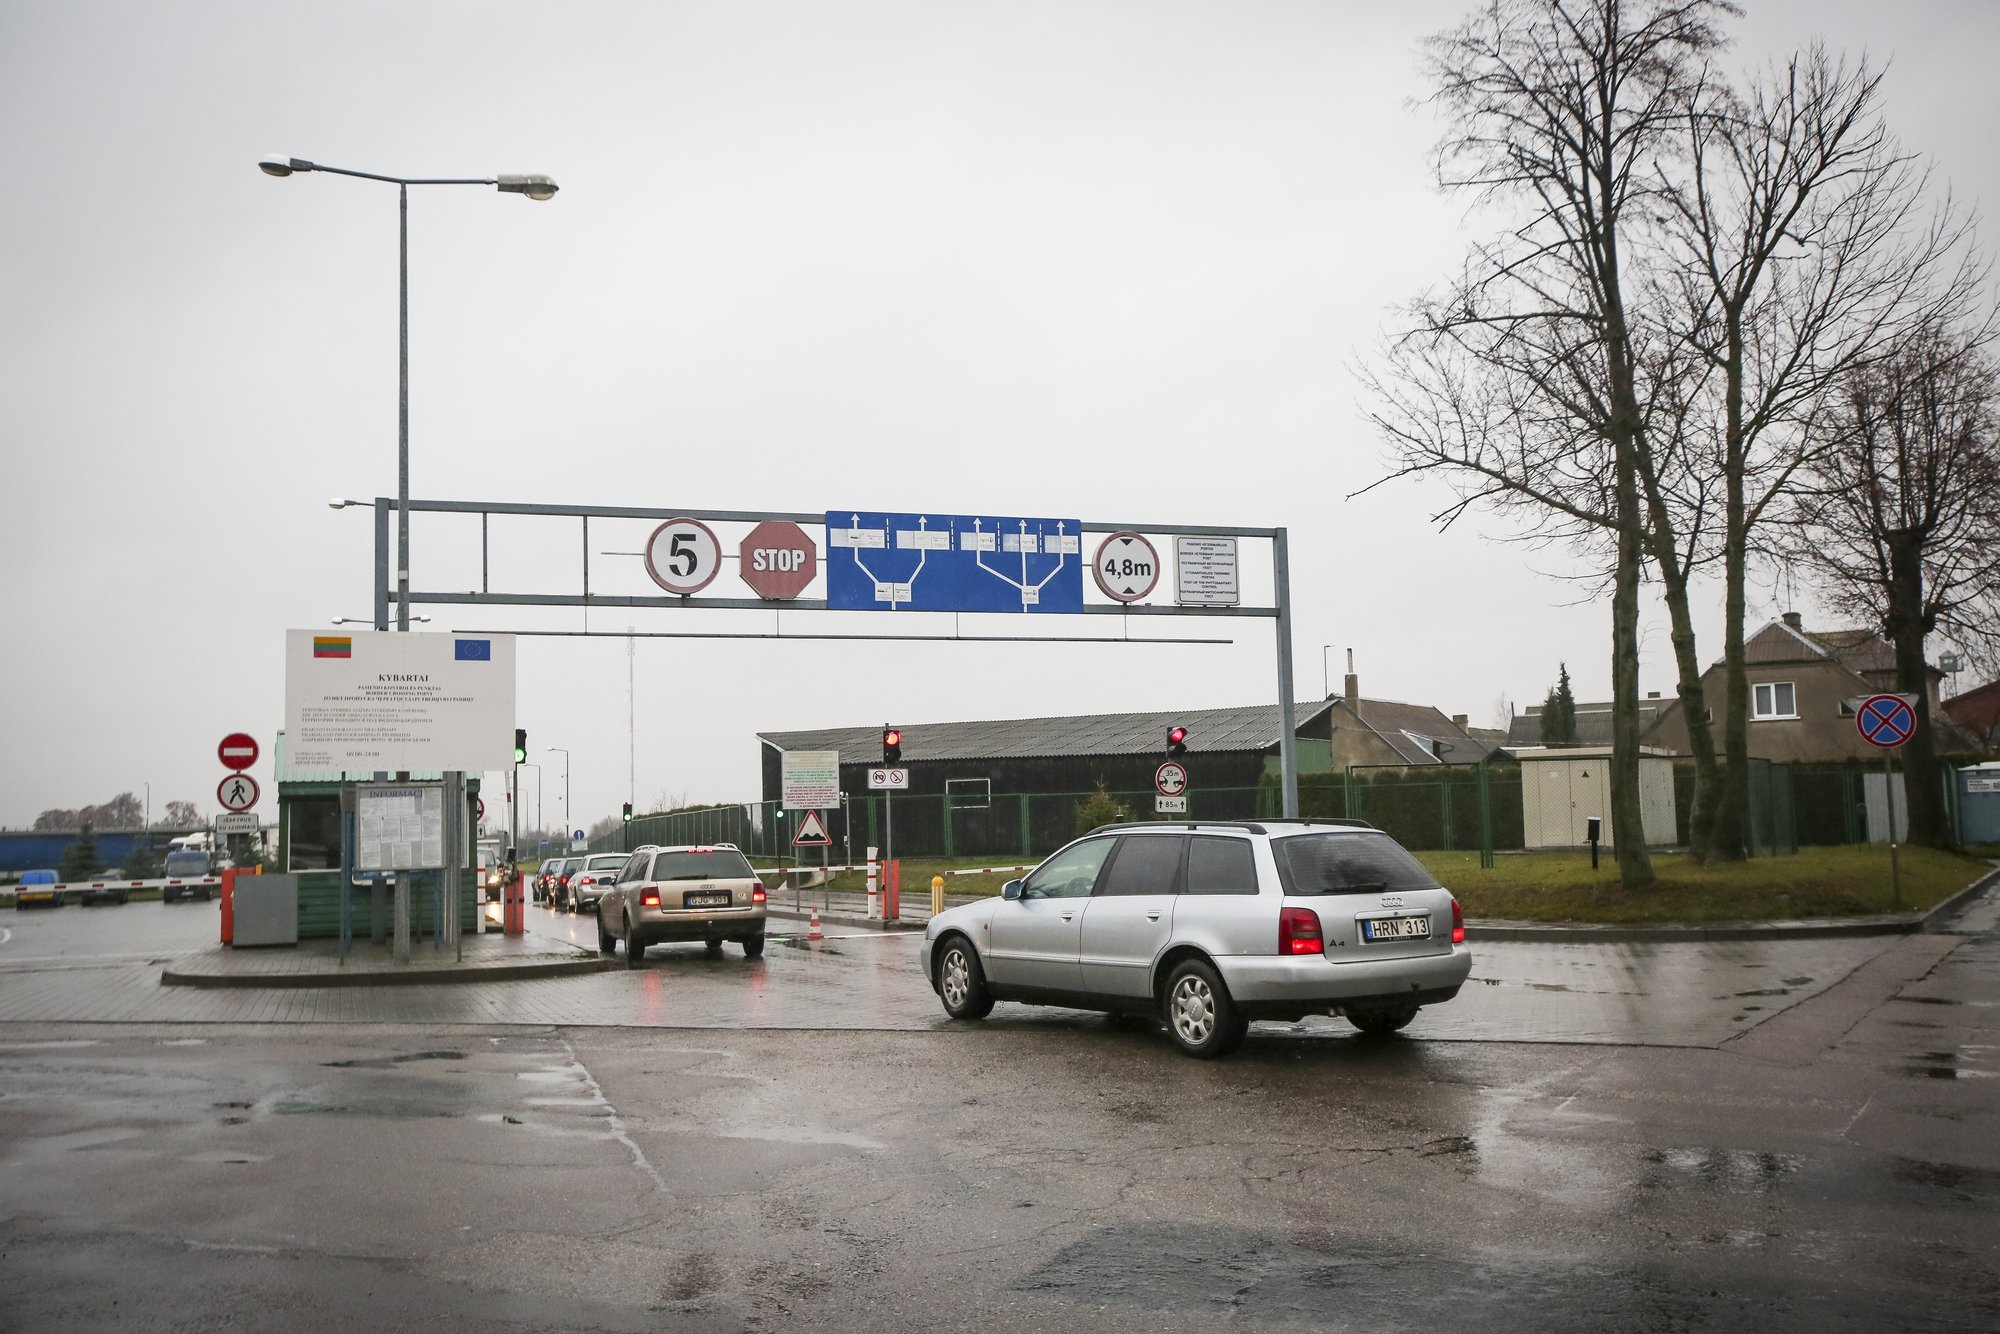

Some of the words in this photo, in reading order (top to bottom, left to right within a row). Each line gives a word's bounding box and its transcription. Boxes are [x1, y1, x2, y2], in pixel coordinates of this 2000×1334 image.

[669, 533, 698, 577] 5
[752, 548, 806, 572] STOP
[1105, 559, 1151, 580] 4,8m
[378, 674, 429, 682] KYBARTAI
[1372, 920, 1400, 937] HRN
[1406, 919, 1428, 934] 313
[1329, 939, 1345, 947] A4
